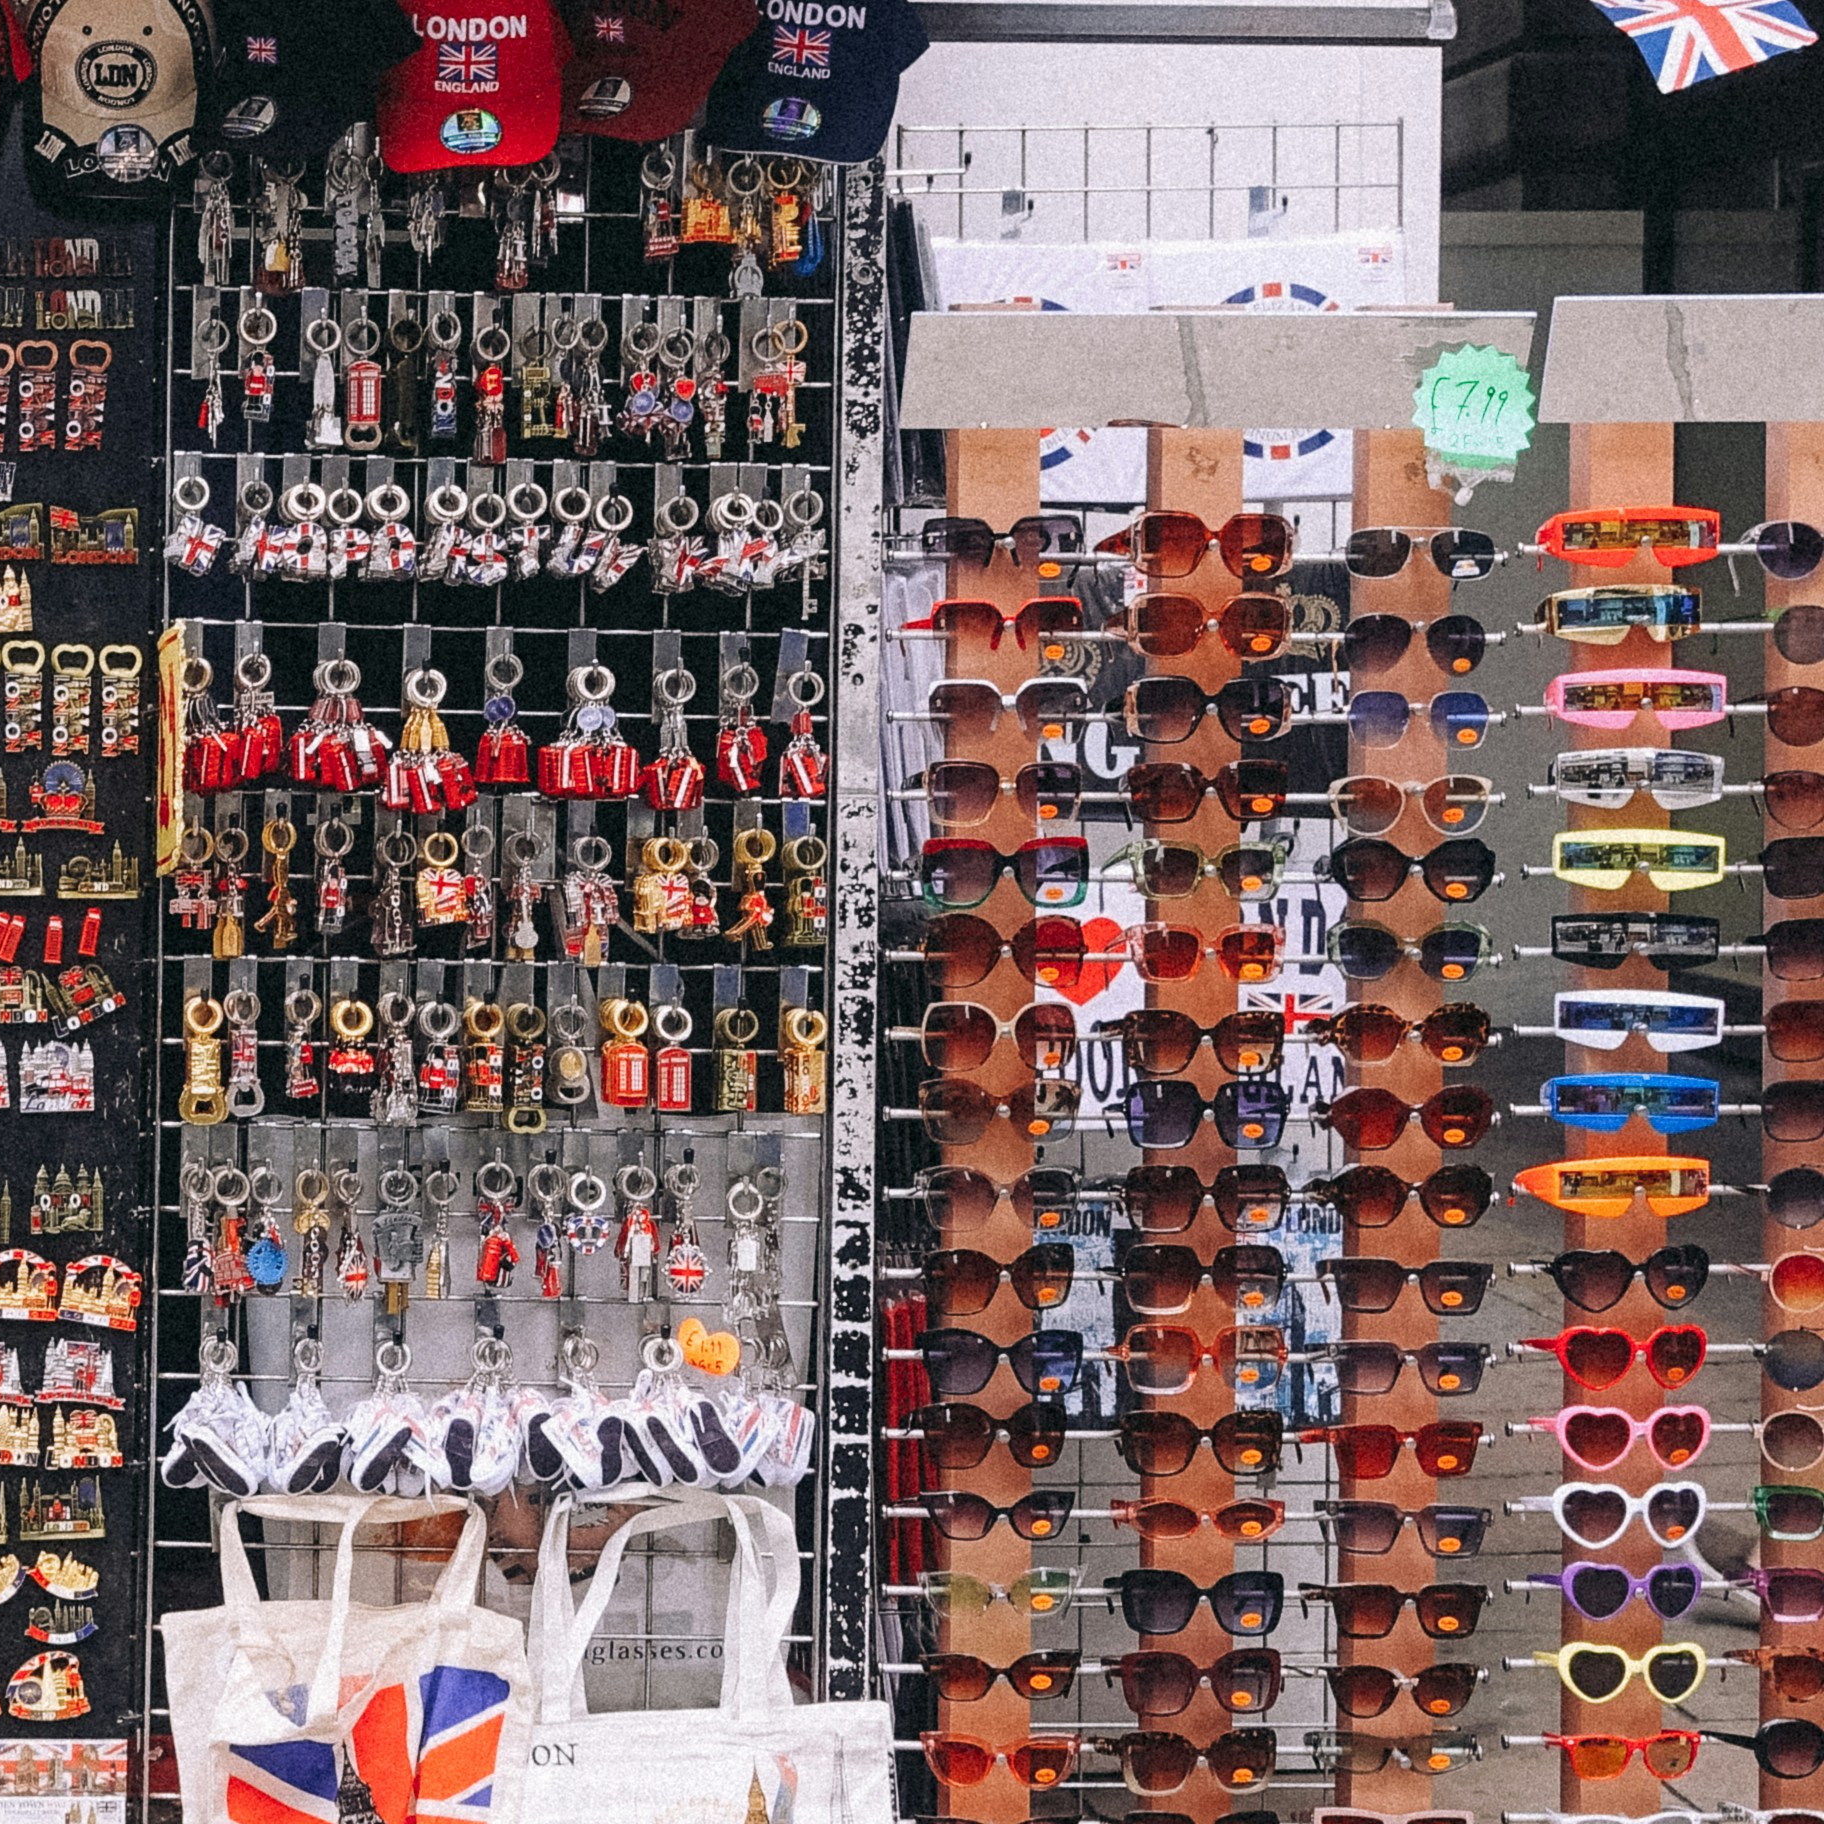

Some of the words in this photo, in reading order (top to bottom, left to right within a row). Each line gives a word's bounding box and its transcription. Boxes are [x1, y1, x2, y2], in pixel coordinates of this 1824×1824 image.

[412, 13, 528, 42] LONDON
[94, 64, 139, 87] LDN
[767, 61, 831, 80] ENGLAND
[434, 80, 499, 94] ENGLAND
[1430, 376, 1509, 434] £7.99
[51, 549, 141, 564] LONDON
